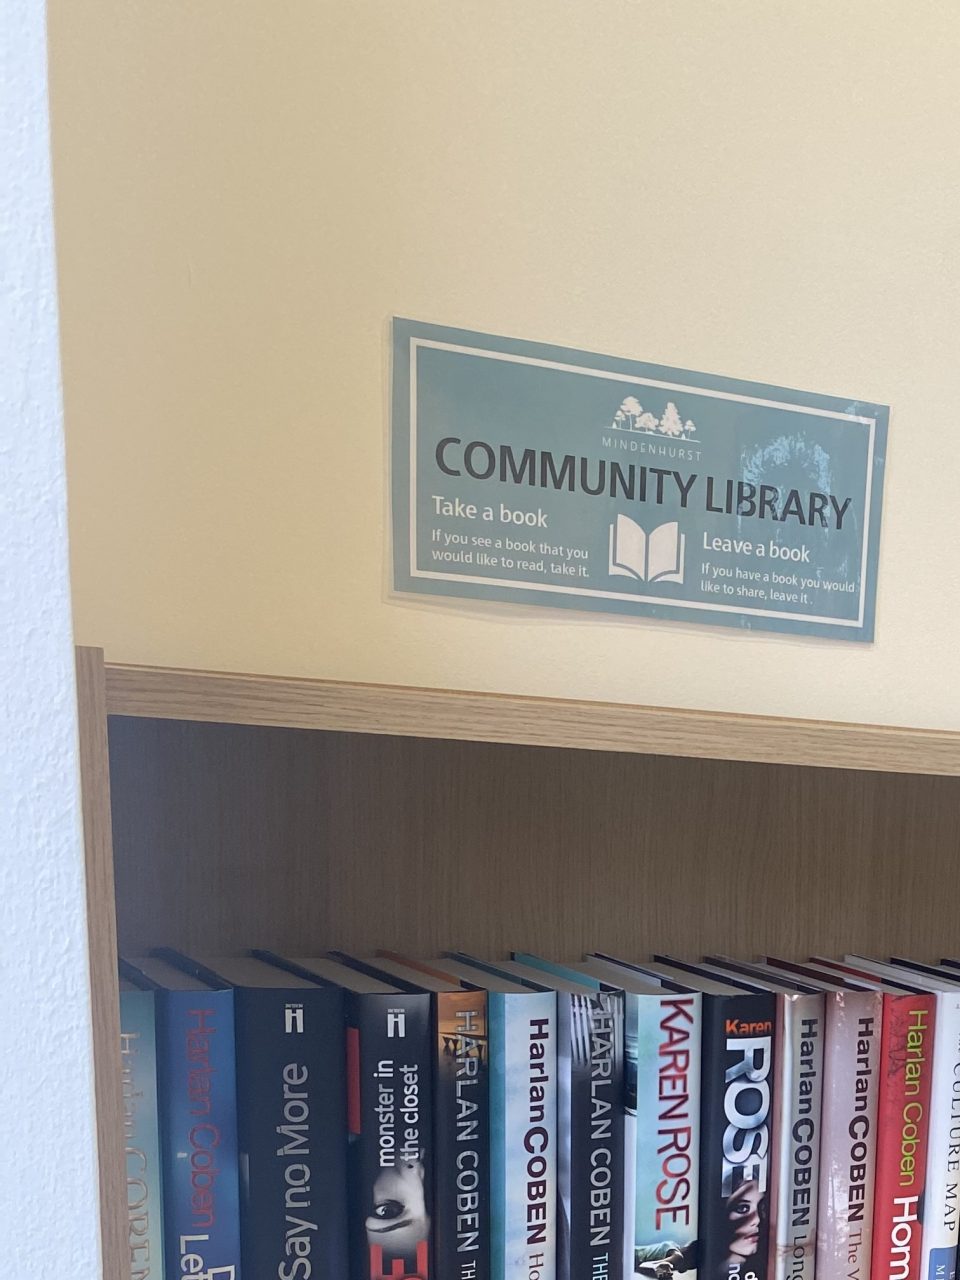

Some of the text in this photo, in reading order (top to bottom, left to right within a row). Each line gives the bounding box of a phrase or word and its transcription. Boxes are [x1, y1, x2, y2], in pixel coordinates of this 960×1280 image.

[435, 437, 852, 530] COMMUNITY LIBRARY
[602, 436, 702, 461] MINDENHURST
[431, 495, 548, 528] Take a book
[431, 529, 588, 560] If you see a book that you
[703, 532, 810, 563] Leave a book
[431, 549, 590, 577] would like to read, take it.
[701, 562, 855, 593] If you have a book you would
[701, 580, 720, 593] like
[723, 583, 734, 595] to
[736, 586, 768, 599] share,
[770, 589, 798, 604] leave
[529, 1018, 549, 1122] Harlan
[725, 1019, 772, 1035] Karen
[187, 1009, 221, 1227] Harlan Coben
[276, 1062, 310, 1156] More
[373, 1059, 395, 1167] monster in
[399, 1064, 420, 1162] the closet
[455, 1010, 479, 1141] HARLAN
[655, 998, 695, 1231] KAREN ROSE
[721, 1035, 772, 1198] ROSE
[285, 1164, 312, 1208] no
[456, 1151, 480, 1252] COBEN
[523, 1126, 549, 1245] COBEN
[944, 1182, 958, 1232] MAP
